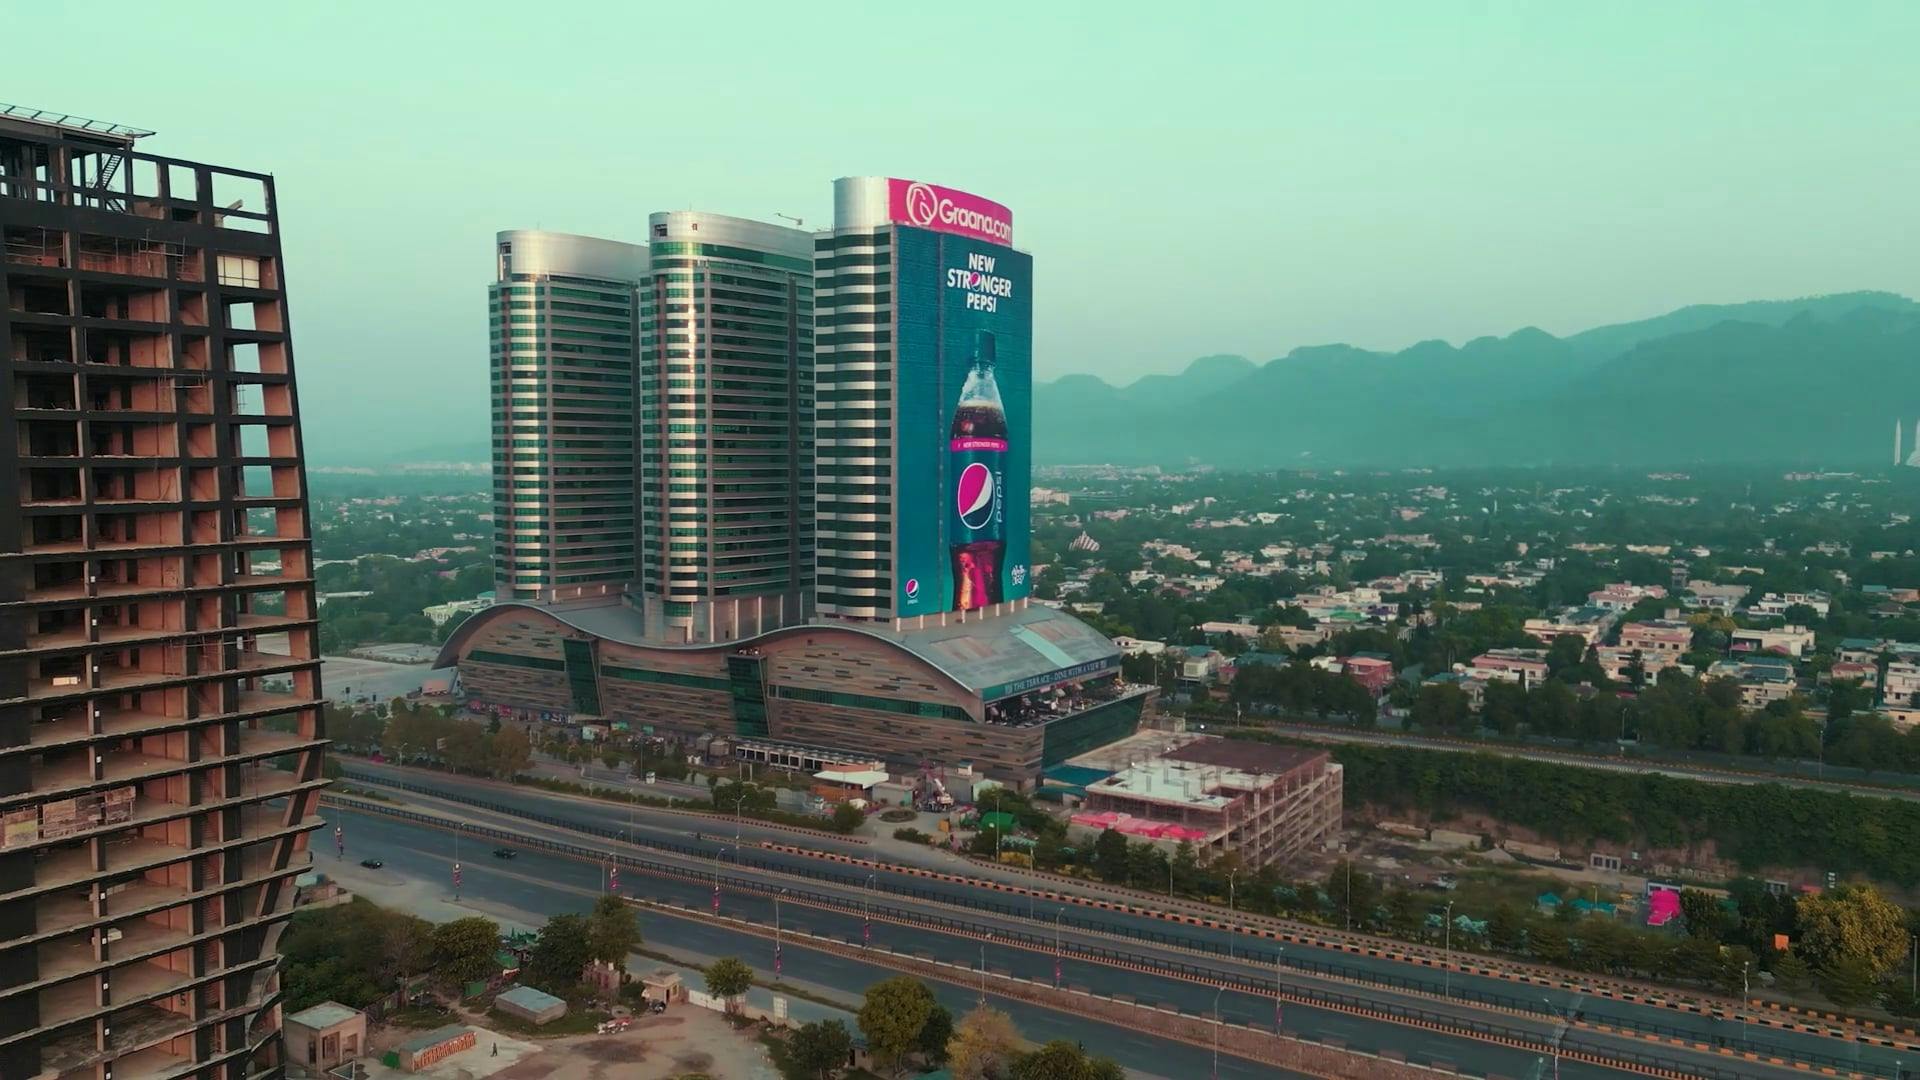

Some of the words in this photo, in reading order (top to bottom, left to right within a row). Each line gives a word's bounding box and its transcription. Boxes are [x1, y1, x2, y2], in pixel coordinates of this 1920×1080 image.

[939, 199, 1012, 240] Graana.com
[969, 252, 995, 273] NEW
[947, 268, 1012, 297] STRONGER
[967, 292, 997, 312] PEPSI
[1014, 681, 1026, 691] THE
[1026, 674, 1050, 688] TERRACE
